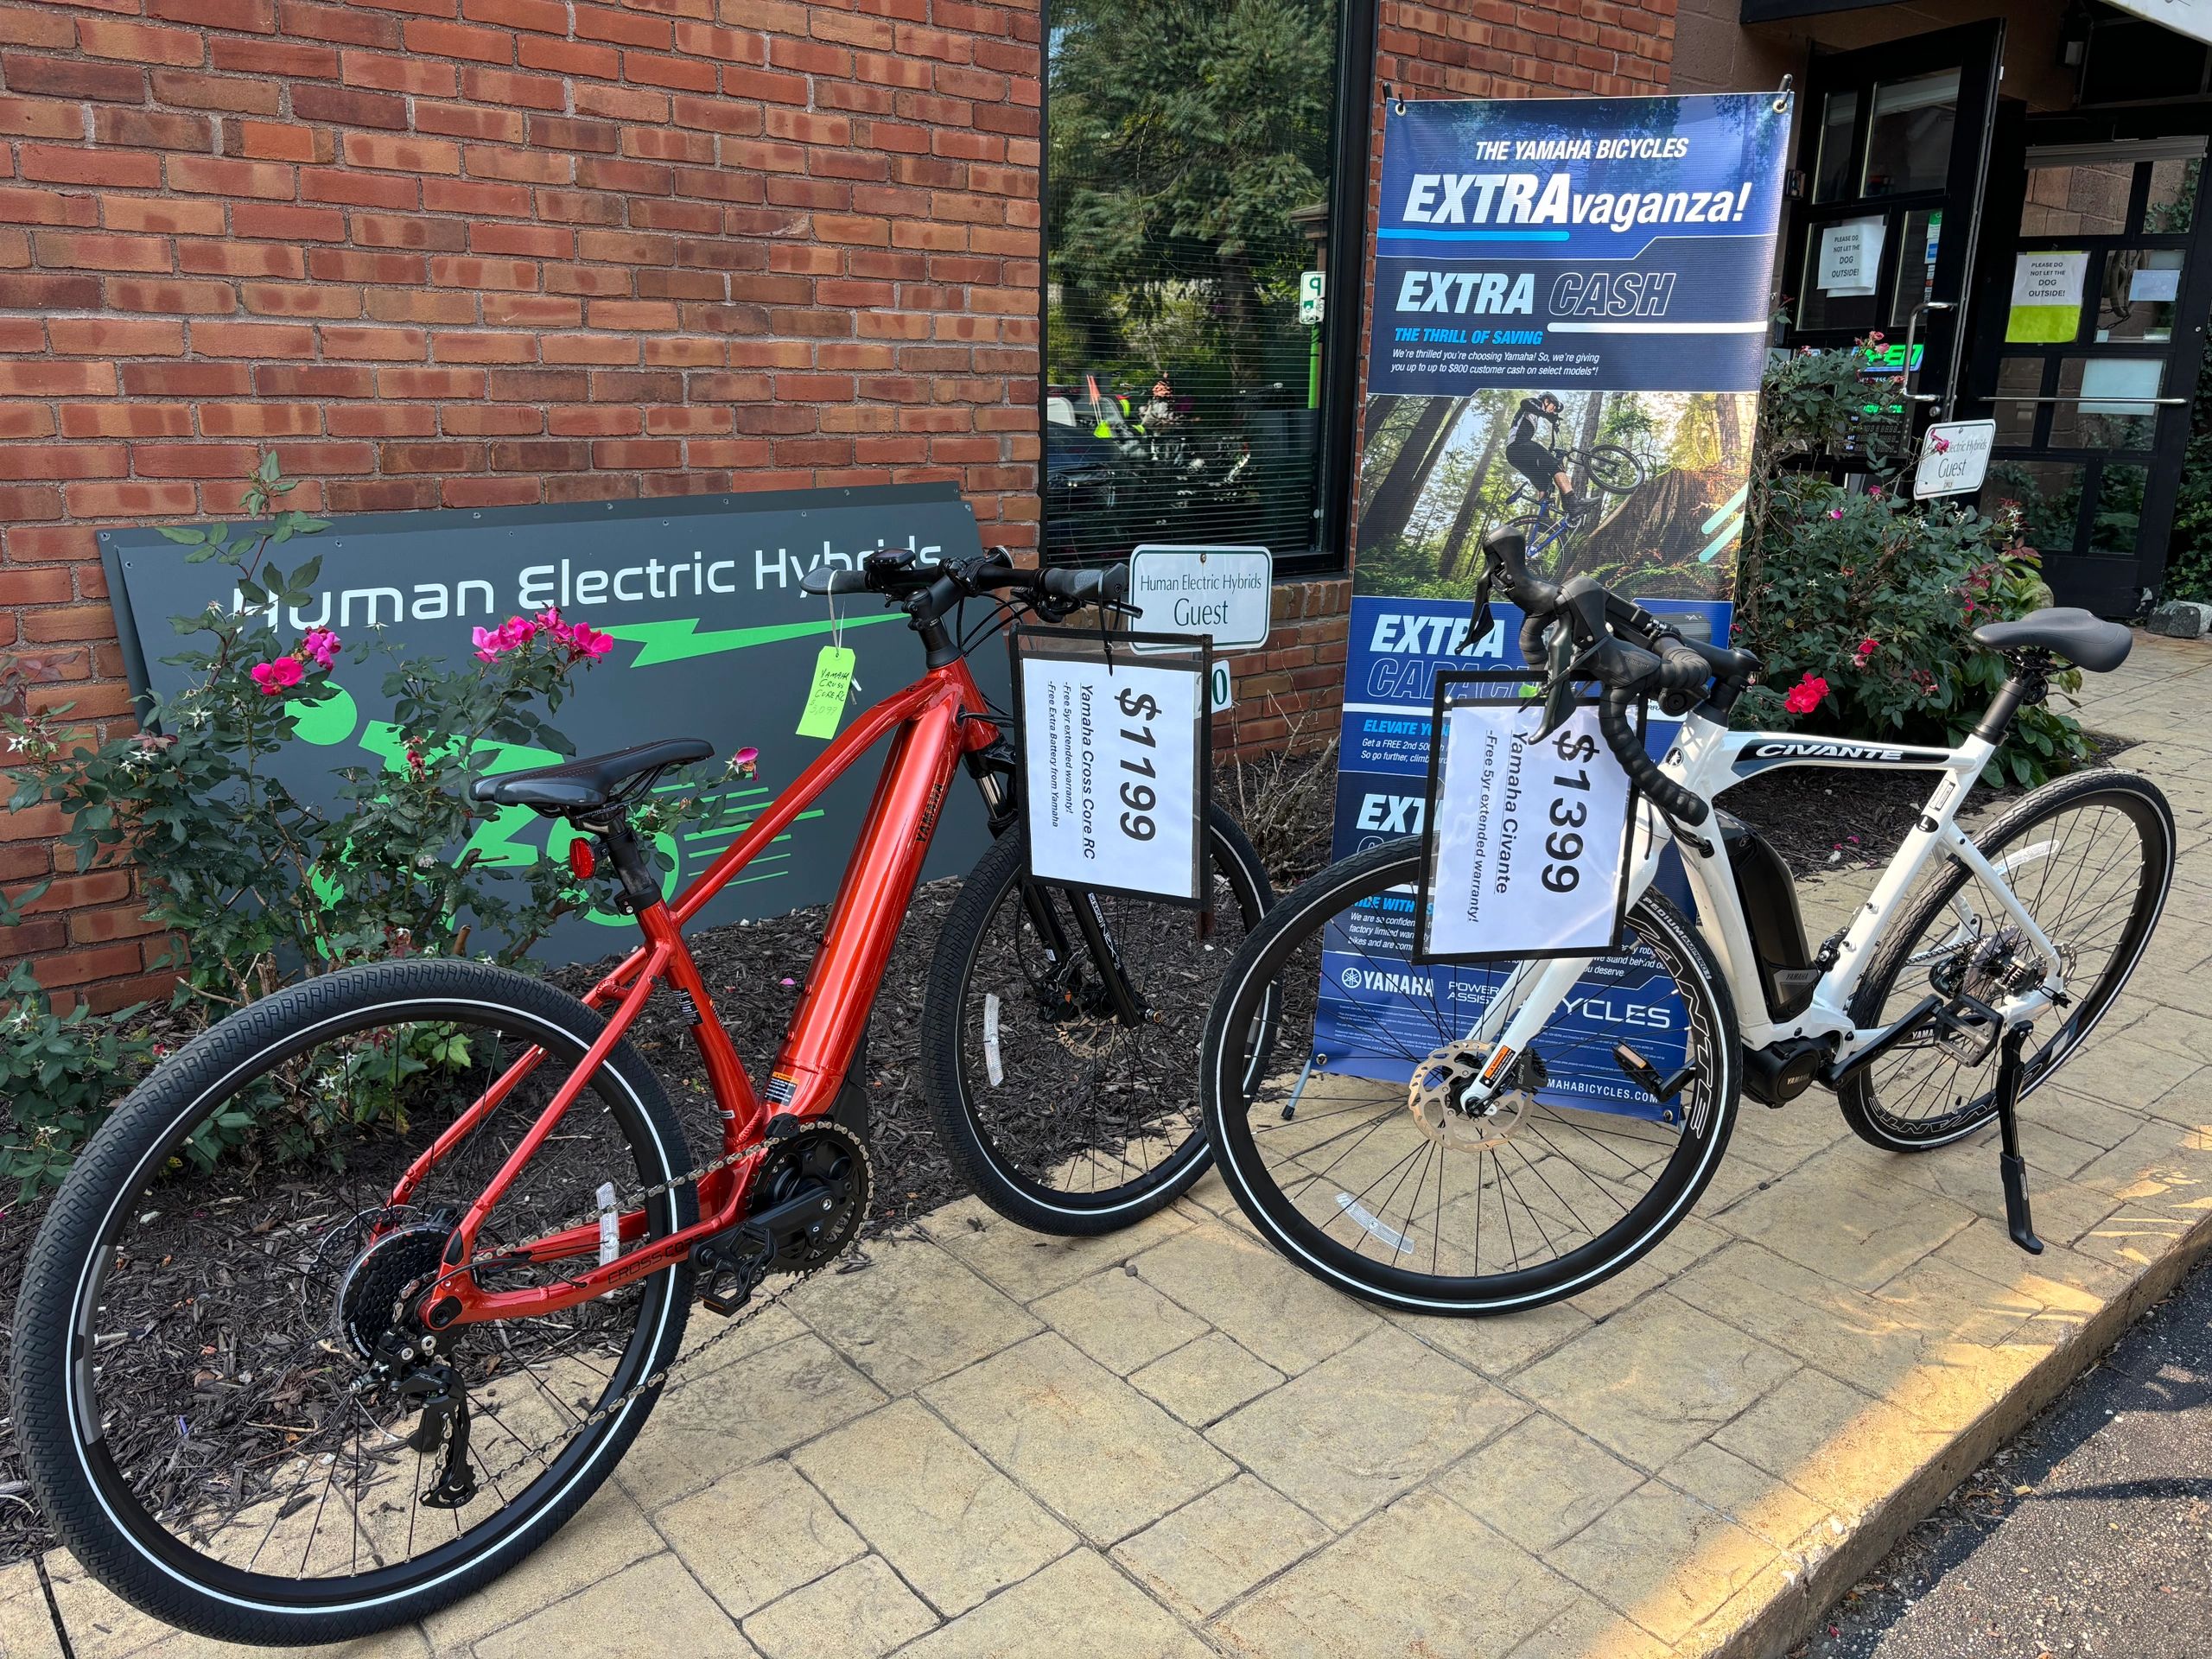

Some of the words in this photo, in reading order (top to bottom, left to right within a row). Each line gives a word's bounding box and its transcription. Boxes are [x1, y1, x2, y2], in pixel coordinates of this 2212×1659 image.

[1475, 141, 1510, 161] THE
[1515, 140, 1591, 161] YAMAHA
[1596, 138, 1689, 159] BICYCLES
[1839, 256, 1854, 264] DOG
[1831, 269, 1859, 278] OUTSIDE!
[1395, 270, 1535, 315] EXTRA
[1548, 272, 1676, 317] CASH
[1395, 327, 1421, 342] THE
[1423, 328, 1467, 344] THRILL
[1471, 330, 1491, 345] OF
[1492, 331, 1543, 346] SAVING
[1392, 348, 1414, 359] We're
[1415, 349, 1442, 359] thrilled
[1442, 351, 1466, 361] you're
[1468, 352, 1503, 363] choosing
[1504, 353, 1537, 362] Yamaha!
[1538, 353, 1550, 363] So,
[1552, 354, 1574, 363] we're
[1575, 353, 1600, 365] giving
[1390, 364, 1406, 373] you
[1407, 364, 1416, 374] up
[1418, 363, 1426, 372] to
[1427, 365, 1438, 374] up
[1440, 364, 1447, 372] to
[1448, 364, 1468, 374] $800
[1470, 365, 1505, 374] customer
[1507, 365, 1525, 375] cash
[1538, 366, 1562, 376] select
[1967, 438, 1987, 454] Hybrids
[1937, 458, 1967, 479] Guest
[518, 550, 736, 610] Electric
[1141, 575, 1179, 592] Human
[1182, 574, 1220, 591] Electric
[1224, 573, 1262, 594] Hybrids
[1174, 598, 1229, 626] Guest
[1369, 613, 1505, 658] EXTRA
[1048, 680, 1057, 706] -Free
[1064, 681, 1072, 707] -Free
[1048, 707, 1058, 731] Extra
[1063, 709, 1072, 724] 5yr
[1081, 684, 1095, 747] Yamaha
[1363, 719, 1419, 735] ELEVATE
[1050, 733, 1058, 767] Battery
[1064, 725, 1073, 769] extended
[1362, 738, 1376, 747] Get
[1382, 740, 1402, 749] FREE
[1402, 741, 1417, 750] 2nd
[1484, 730, 1498, 766] -Free
[1755, 743, 1904, 760] CIVANTE
[1114, 687, 1162, 842] $1199
[1361, 750, 1371, 759] So
[1371, 753, 1382, 761] go
[1382, 752, 1408, 763] further,
[1409, 753, 1429, 764] climb
[1050, 768, 1058, 790] from
[1082, 750, 1095, 795] Cross
[1481, 769, 1495, 792] 5yr
[1504, 732, 1529, 813] Yamaha
[1065, 770, 1074, 815] warranty!
[915, 783, 944, 843] YAMAHA
[1051, 791, 1060, 828] Yamaha
[1083, 798, 1095, 835] Core
[1541, 730, 1600, 893] $1399
[1476, 793, 1492, 858] extended
[1084, 837, 1096, 860] RC
[1496, 817, 1519, 894] Civante
[1467, 859, 1484, 924] warranty!
[1382, 897, 1415, 913] WITH
[1643, 896, 1685, 937] PEDIUM
[1349, 924, 1374, 936] factory
[1374, 926, 1399, 938] limited
[1351, 912, 1362, 921] We
[1363, 914, 1375, 923] are
[1386, 917, 1416, 927] confiden
[1348, 936, 1367, 946] bikes
[1367, 938, 1382, 948] and
[1593, 965, 1626, 977] deserve.
[1606, 956, 1630, 965] stand
[1629, 956, 1655, 968] behind
[1363, 970, 1434, 997] YAMAHA
[1448, 981, 1499, 995] POWER
[1785, 973, 1808, 982] YAMAHA
[1911, 1028, 1935, 1039] YAMA
[1787, 1072, 1810, 1085] YAMAHA
